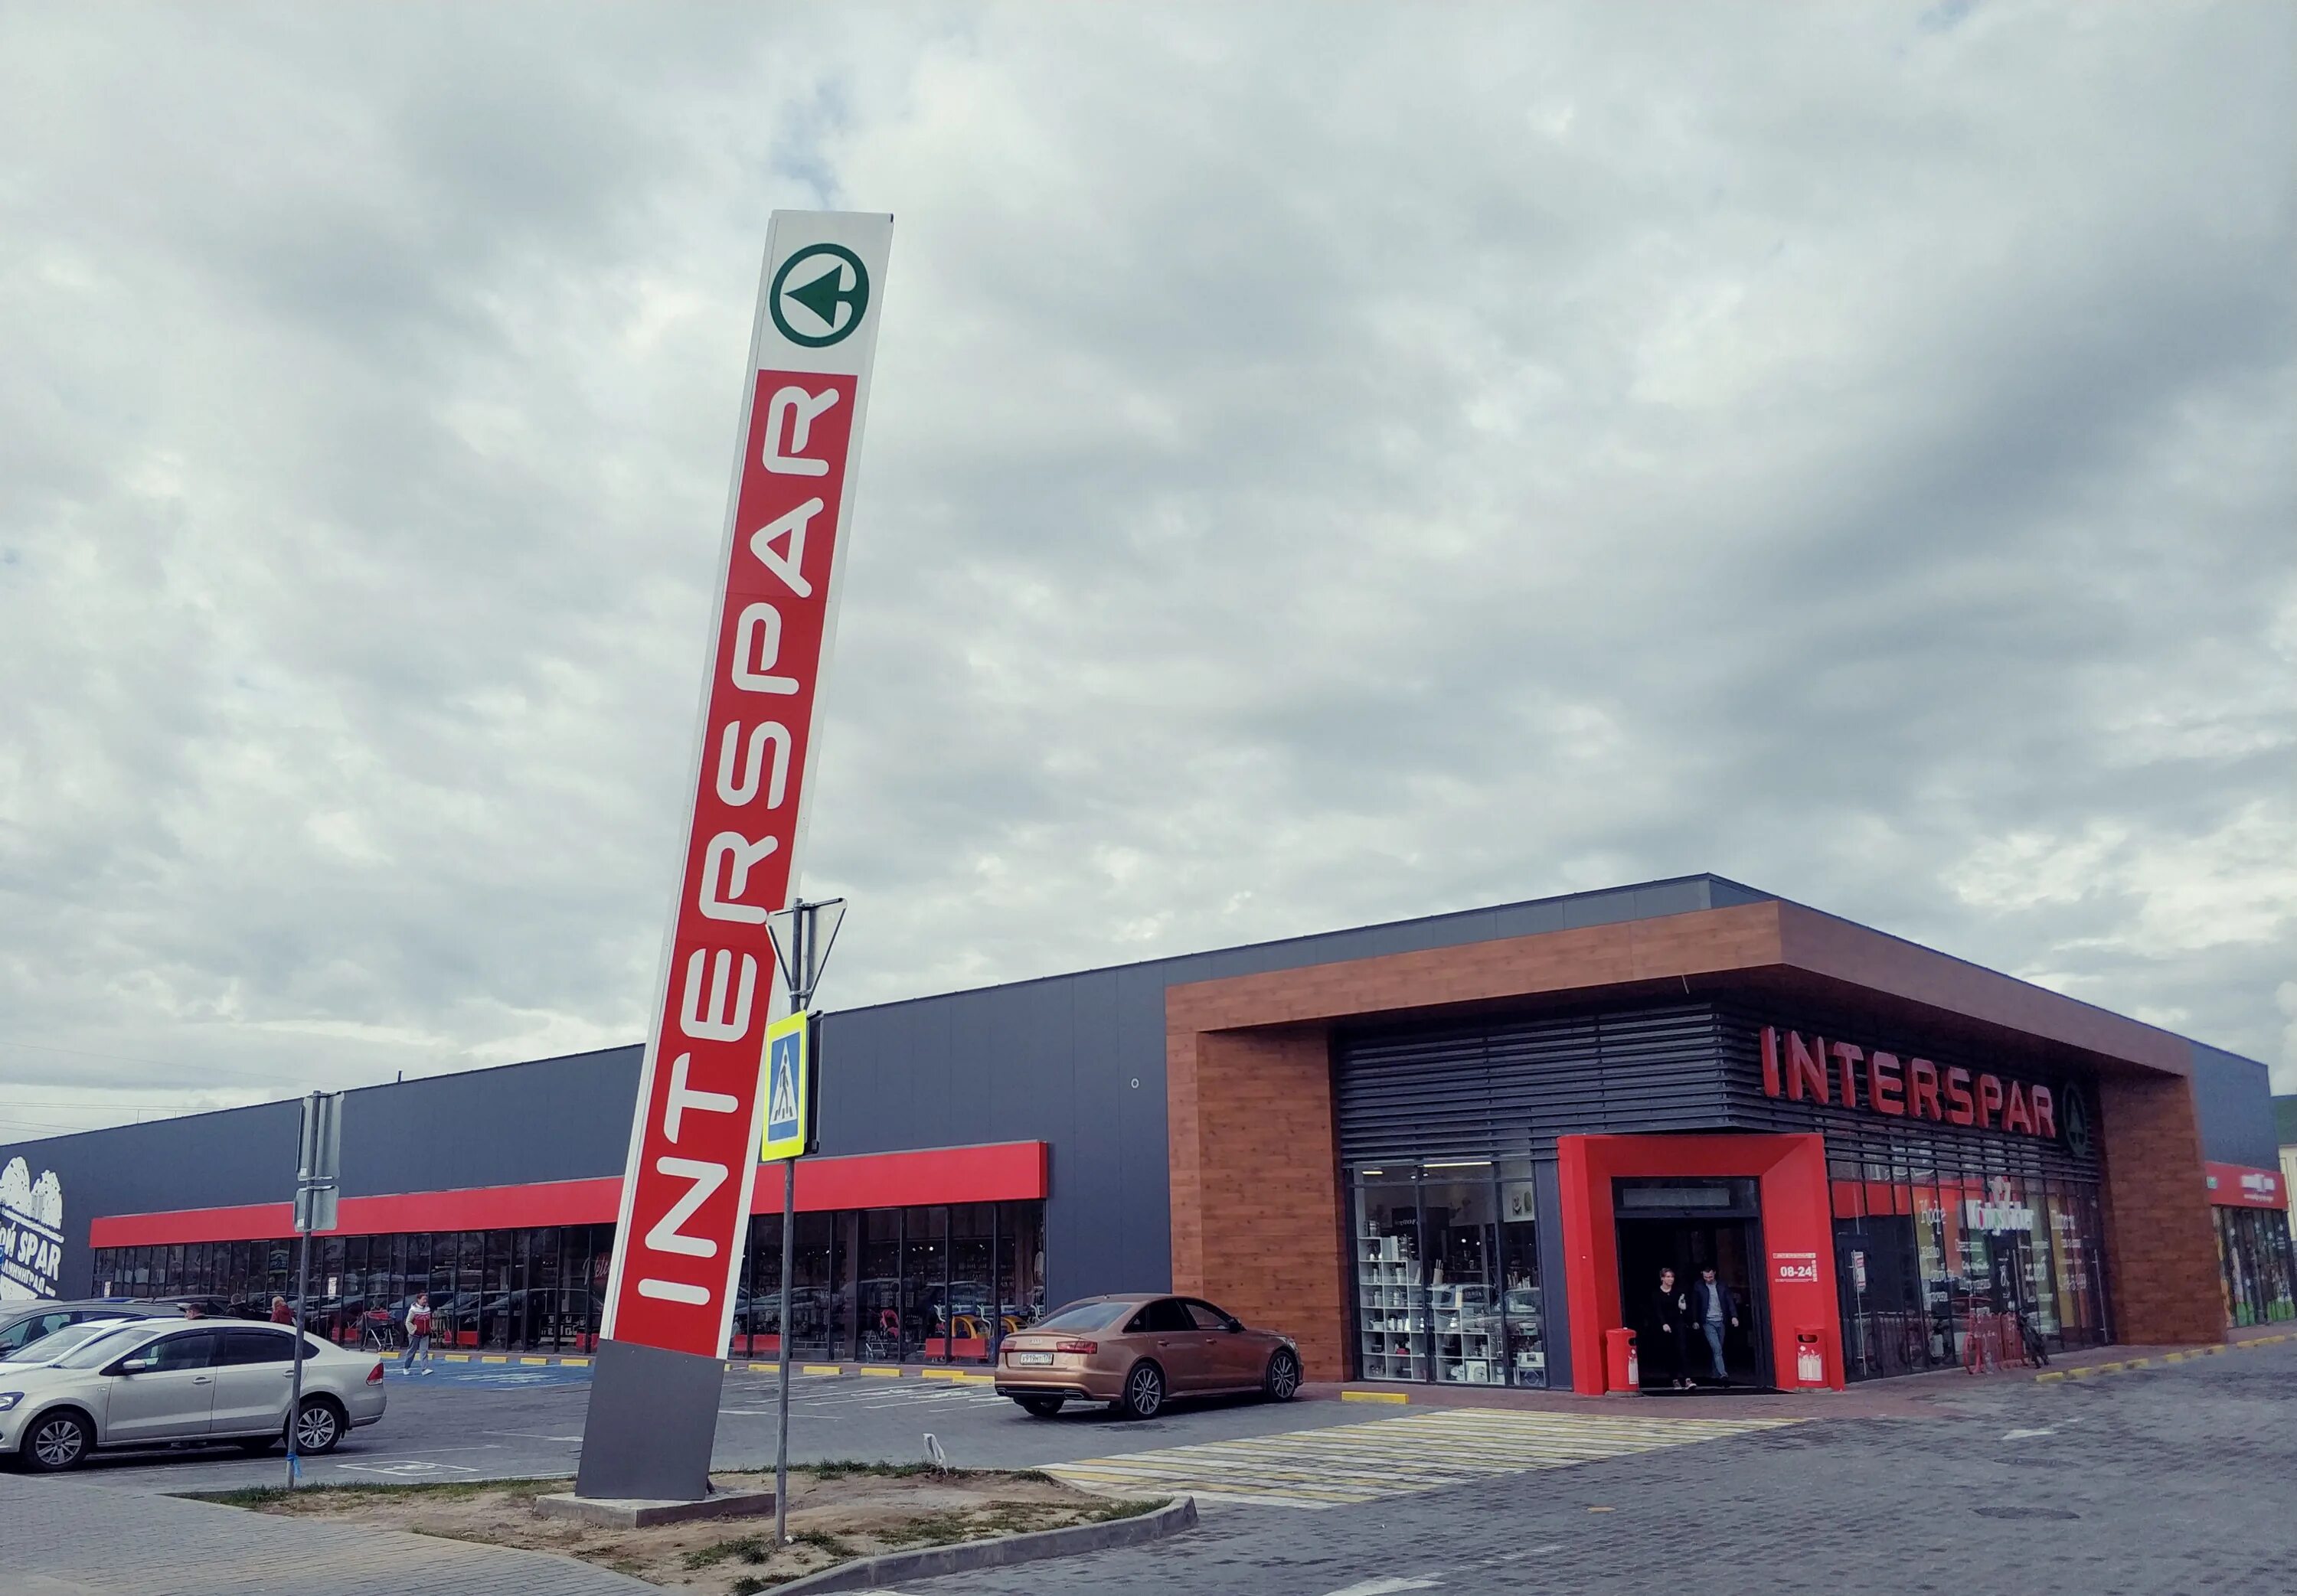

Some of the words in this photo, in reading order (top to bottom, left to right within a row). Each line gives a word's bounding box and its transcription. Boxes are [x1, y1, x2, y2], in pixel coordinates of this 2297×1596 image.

[638, 386, 839, 1305] INTERSPAR
[1760, 1025, 2056, 1137] INTERSPAR
[2, 1259, 46, 1294] ЛИНИНГРАД
[18, 1230, 62, 1281] SPAR
[1780, 1266, 1812, 1277] 08-24
